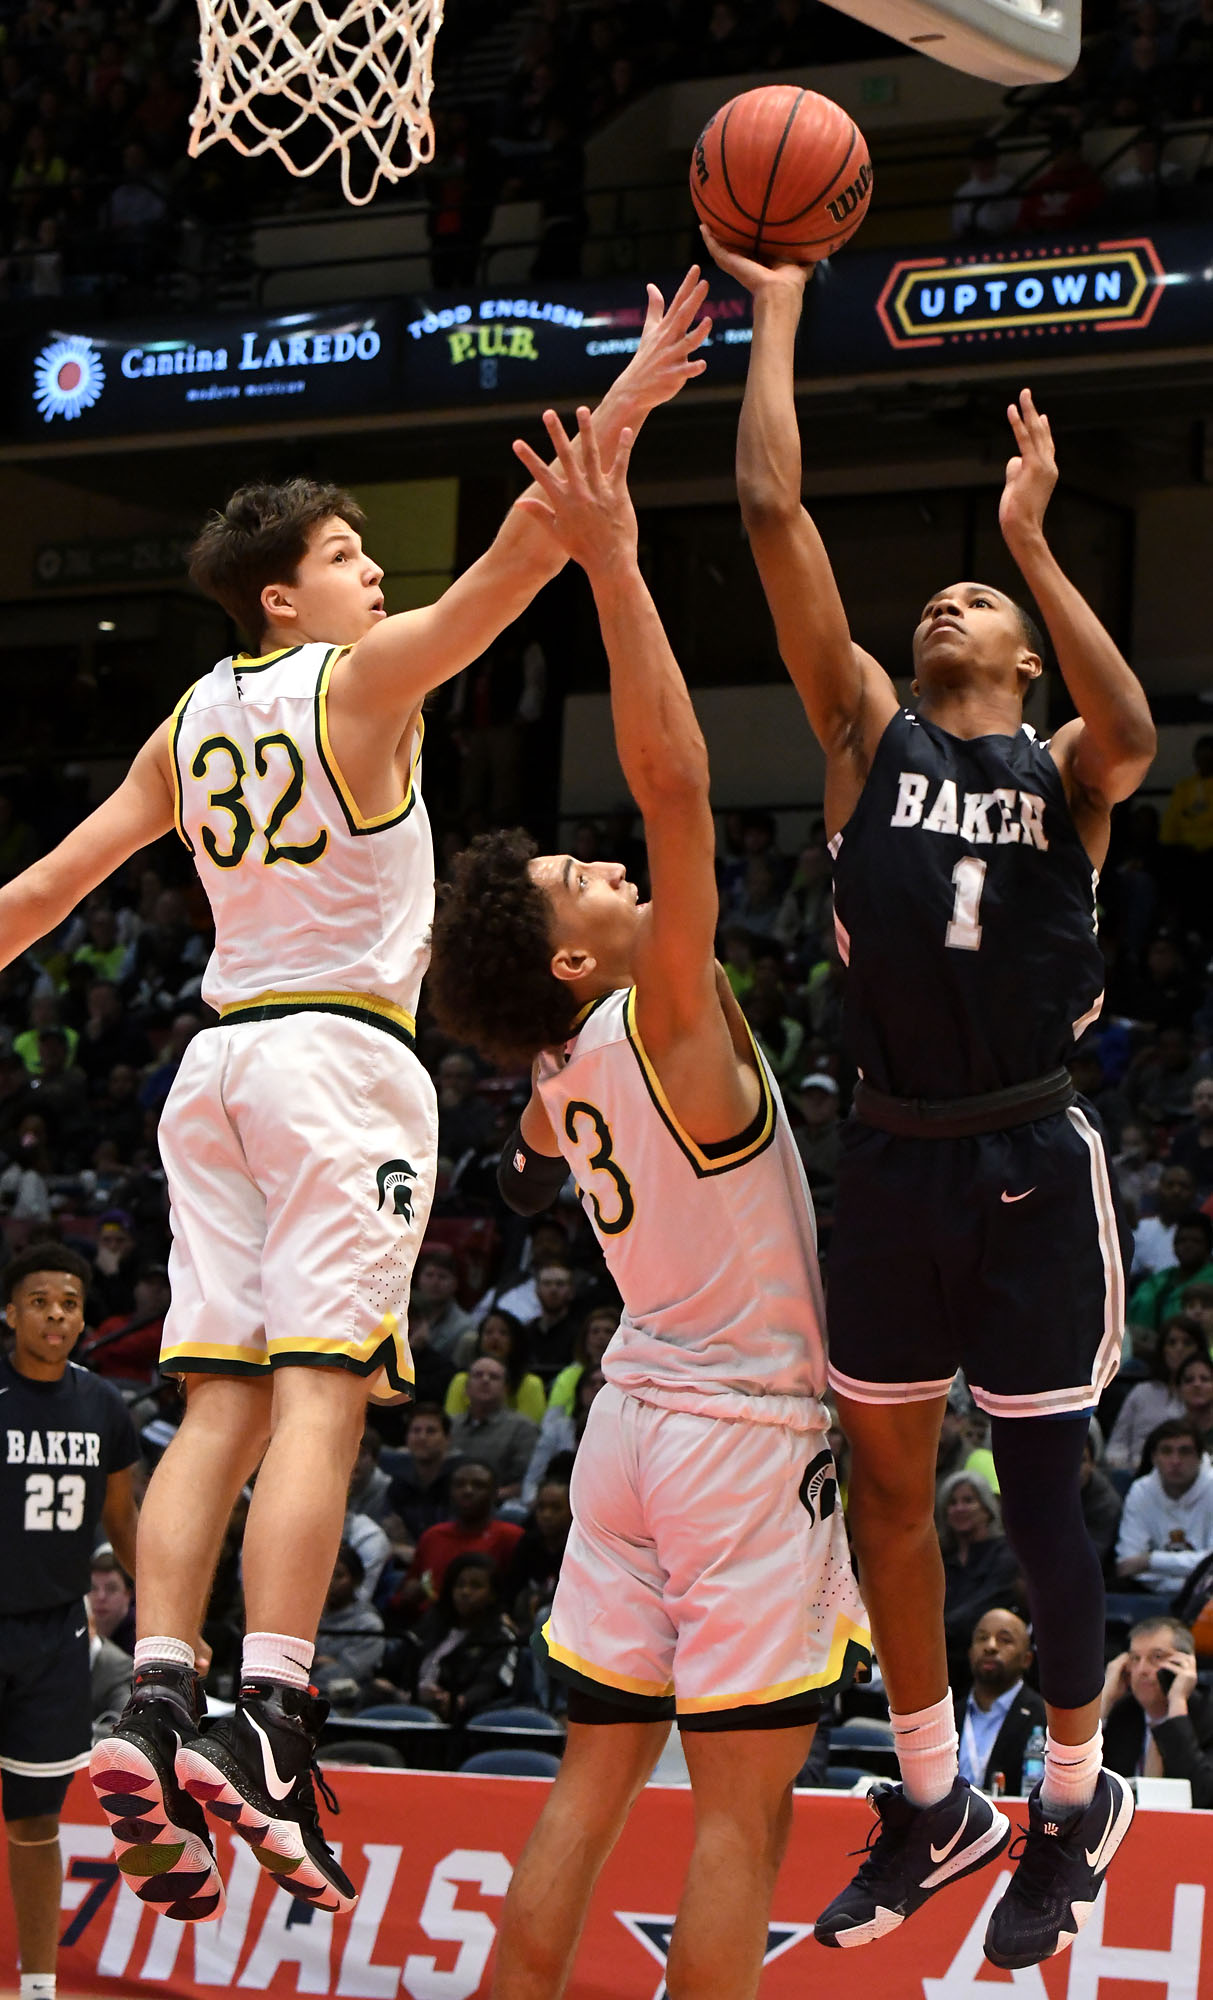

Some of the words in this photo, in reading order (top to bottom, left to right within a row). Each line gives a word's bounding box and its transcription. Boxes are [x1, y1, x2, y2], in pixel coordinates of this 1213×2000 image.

[479, 299, 584, 330] ENGLISH
[920, 270, 1121, 318] UPTOWN
[121, 345, 228, 379] Cantina
[238, 331, 381, 371] LAREDO
[448, 324, 539, 364] P.U.B.
[190, 730, 329, 871] 32
[890, 771, 1049, 852] BAKER
[944, 856, 987, 951] 1
[563, 1098, 635, 1237] 3
[6, 1429, 100, 1467] BAKER
[24, 1473, 86, 1531] 23
